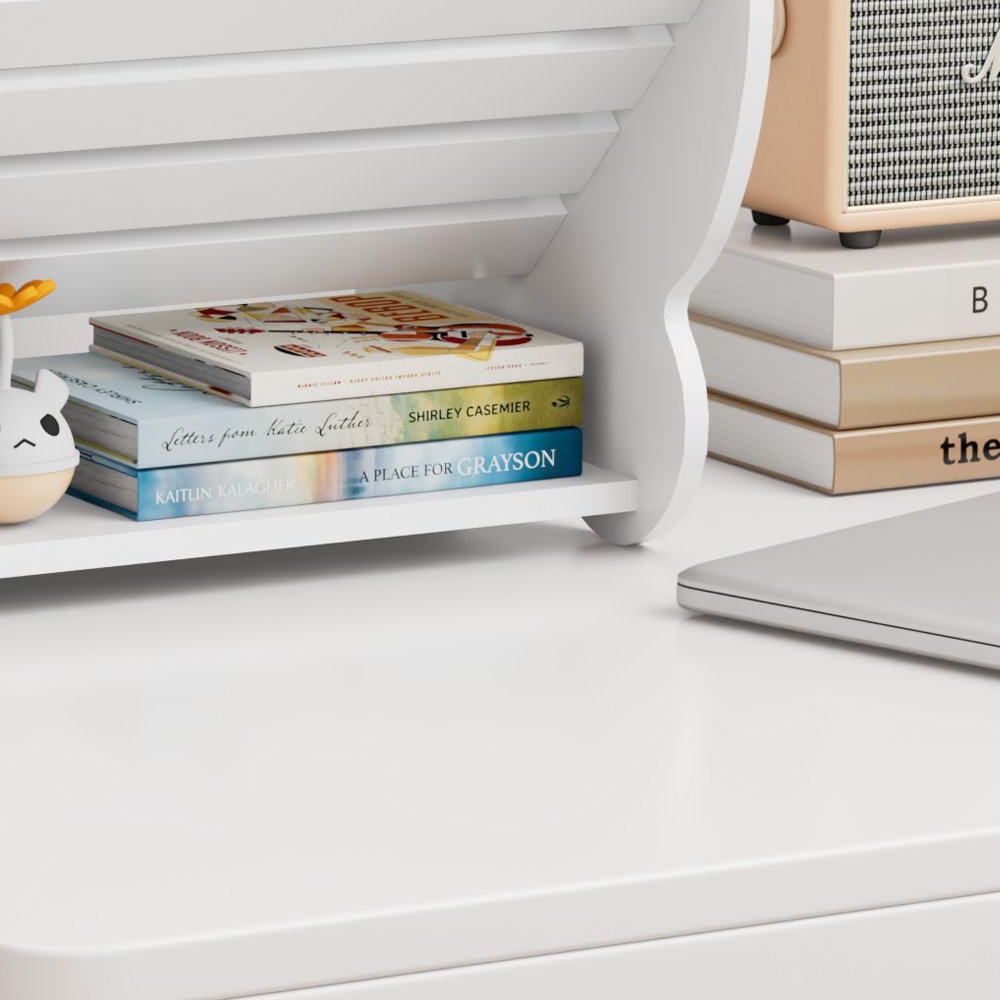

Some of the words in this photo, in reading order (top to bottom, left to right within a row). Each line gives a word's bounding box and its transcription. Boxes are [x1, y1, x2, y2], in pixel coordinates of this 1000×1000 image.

[972, 286, 988, 314] B
[408, 407, 461, 423] SHIRLEY
[466, 400, 531, 418] CASEMIER
[162, 427, 214, 452] Letters
[265, 417, 307, 438] Katie
[315, 410, 373, 437] Luther
[940, 432, 1000, 465] the
[358, 469, 369, 484] A
[374, 465, 419, 482] PLACE
[424, 462, 453, 477] FOR
[457, 449, 556, 477] GRAYSON
[155, 486, 212, 505] KAITLIN
[217, 478, 295, 498] KALAGHER
